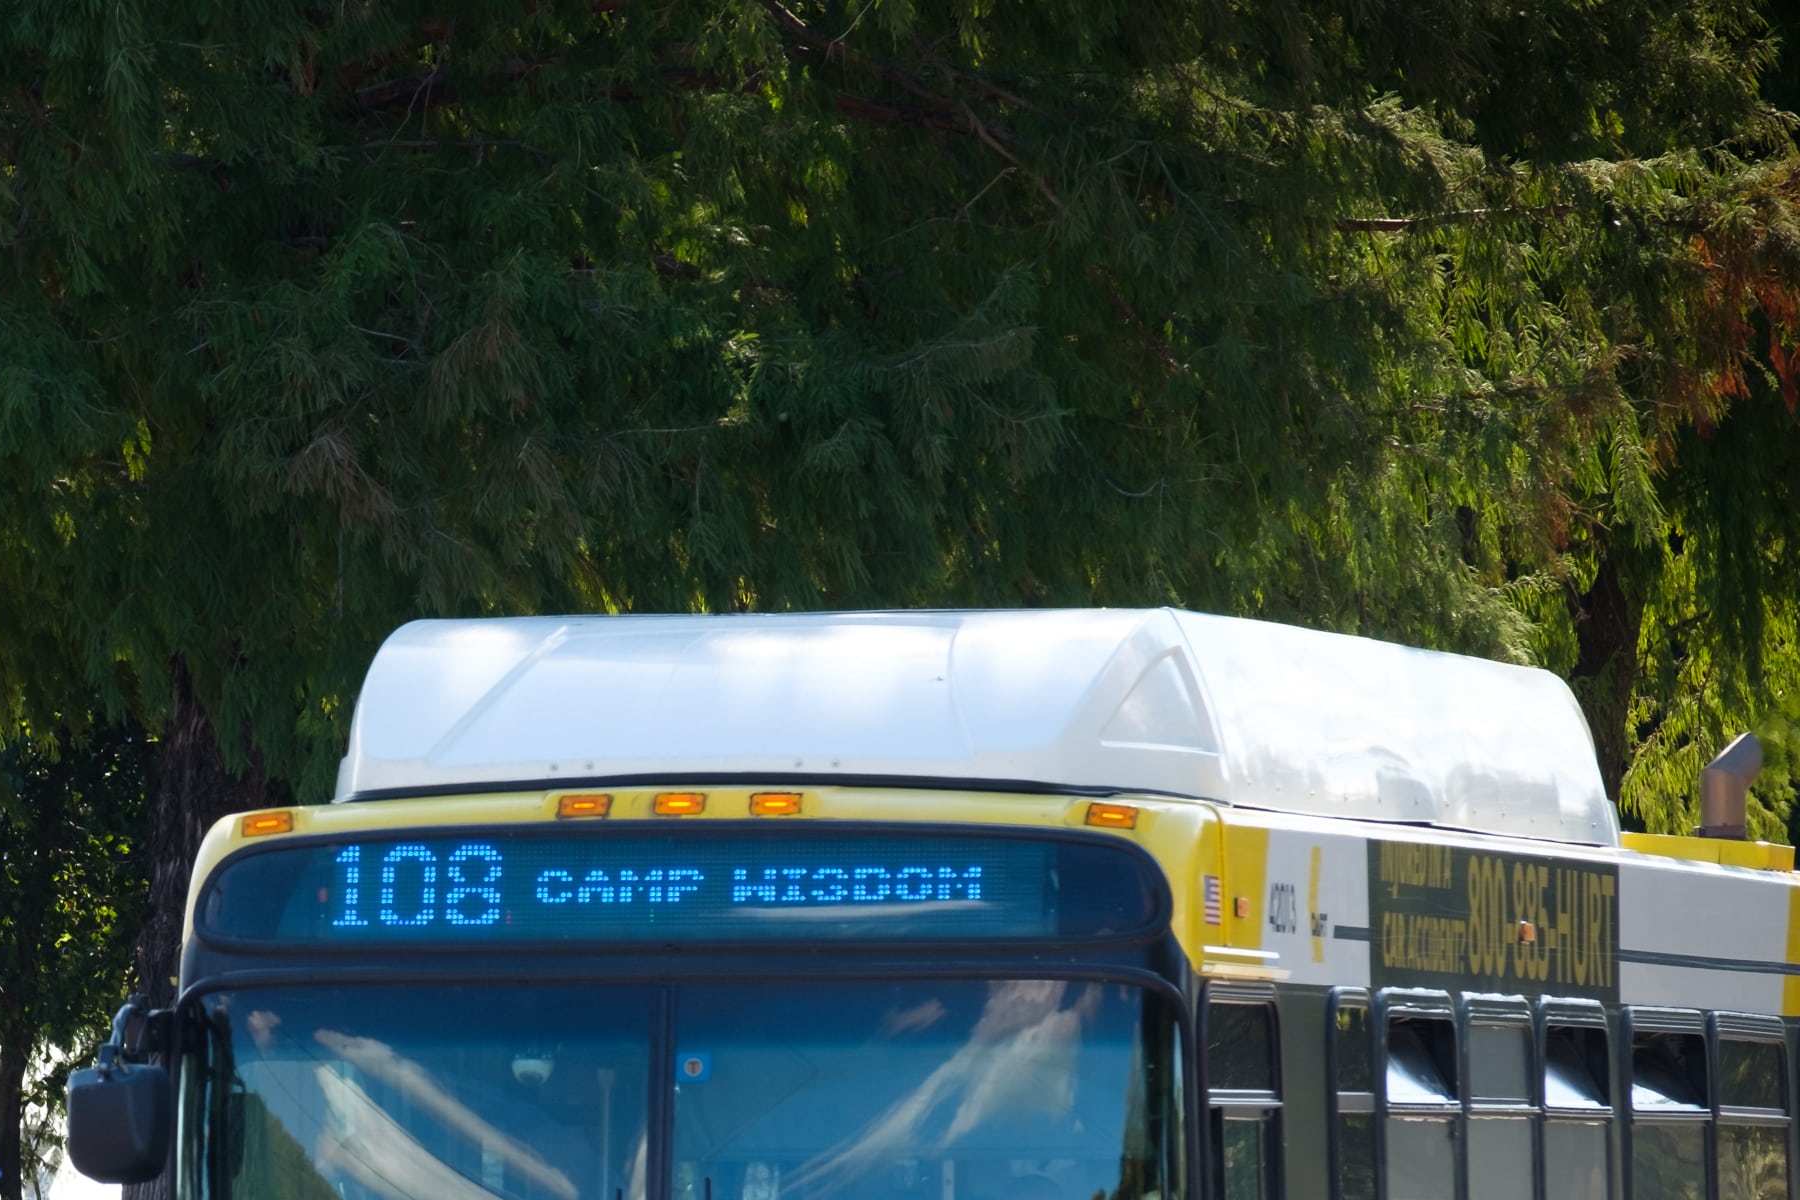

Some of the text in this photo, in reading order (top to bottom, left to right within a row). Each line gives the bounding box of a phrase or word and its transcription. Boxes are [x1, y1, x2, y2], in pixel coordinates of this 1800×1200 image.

[332, 844, 983, 926] 108 CAMP WISDOM
[1467, 855, 1615, 988] 800-885-HURT
[1383, 911, 1405, 968] CAR
